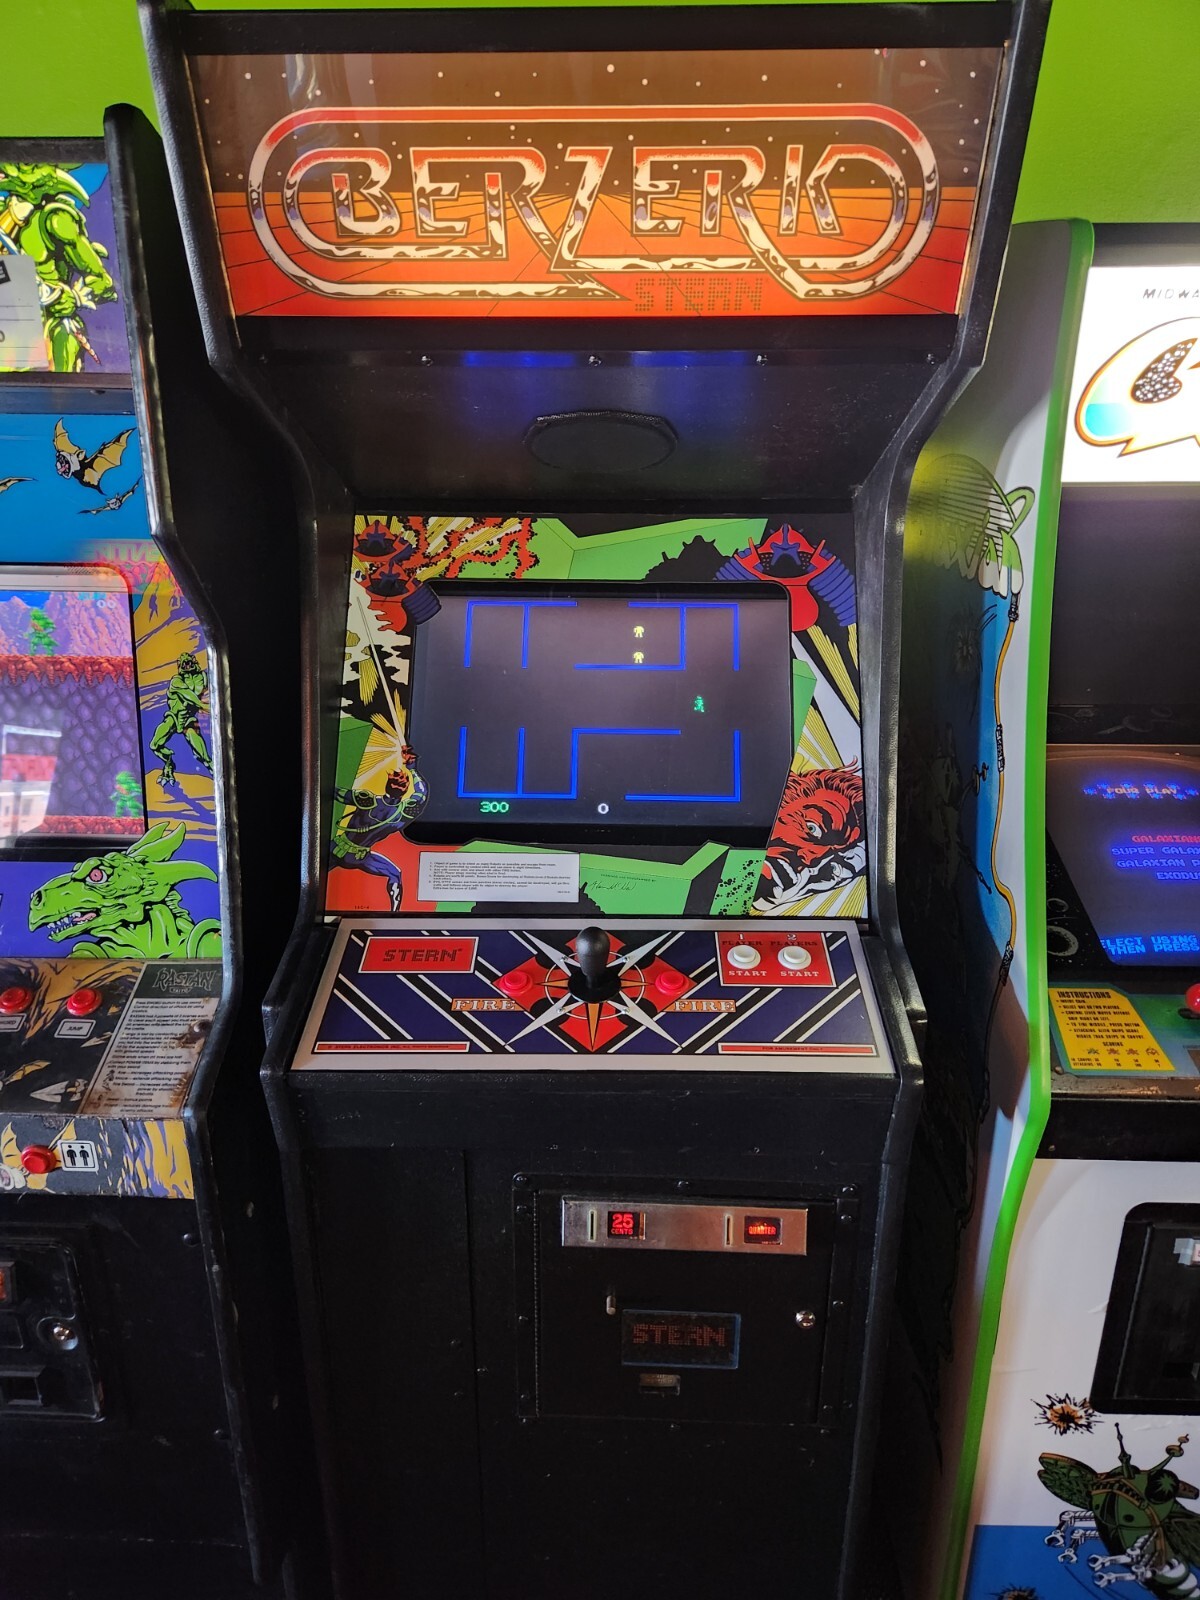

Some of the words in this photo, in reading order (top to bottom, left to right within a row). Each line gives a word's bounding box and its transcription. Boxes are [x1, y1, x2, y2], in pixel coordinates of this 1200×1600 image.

[282, 143, 908, 298] BERZERK
[634, 278, 763, 312] STERN
[480, 802, 509, 813] 300
[597, 803, 609, 814] 0
[1112, 847, 1154, 855] SUPER
[1117, 859, 1185, 867] GALAXIAN
[1151, 935, 1198, 944] USING
[382, 948, 458, 962] STERN
[152, 967, 217, 992] RASTAN
[455, 1000, 516, 1011] FIRE
[674, 1000, 735, 1011] FIRE
[612, 1213, 634, 1229] 25
[748, 1226, 777, 1235] QUARTER
[633, 1324, 725, 1346] STERN
